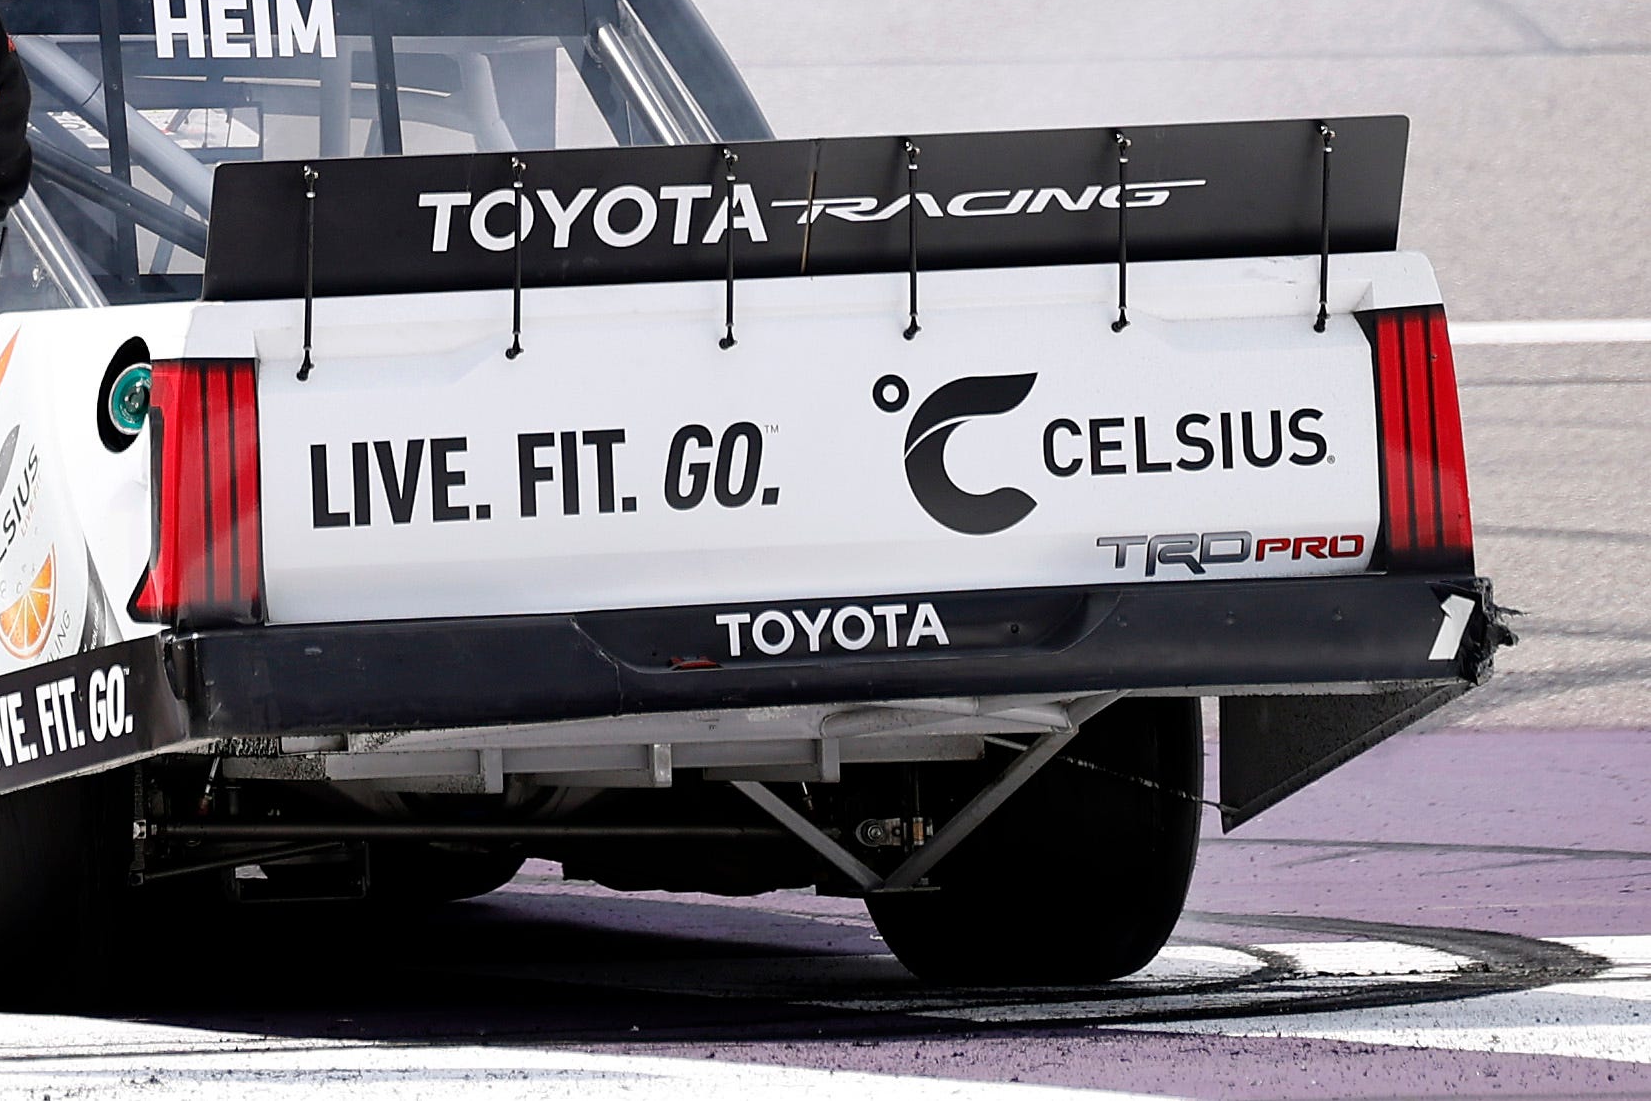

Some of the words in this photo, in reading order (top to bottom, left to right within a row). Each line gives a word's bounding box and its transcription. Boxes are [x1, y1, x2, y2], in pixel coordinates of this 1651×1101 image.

[418, 183, 770, 252] TOYOTA
[771, 179, 1207, 223] RACING
[310, 436, 491, 529] LIVE.
[518, 428, 637, 518] FIT.
[664, 421, 780, 511] GO.
[1043, 407, 1329, 478] CELSIUS
[1096, 531, 1252, 577] TRD
[1254, 534, 1365, 562] PRO
[715, 602, 950, 657] TOYOTA
[1427, 593, 1476, 660] 1
[35, 676, 86, 756] FIT.
[89, 664, 134, 742] GO.
